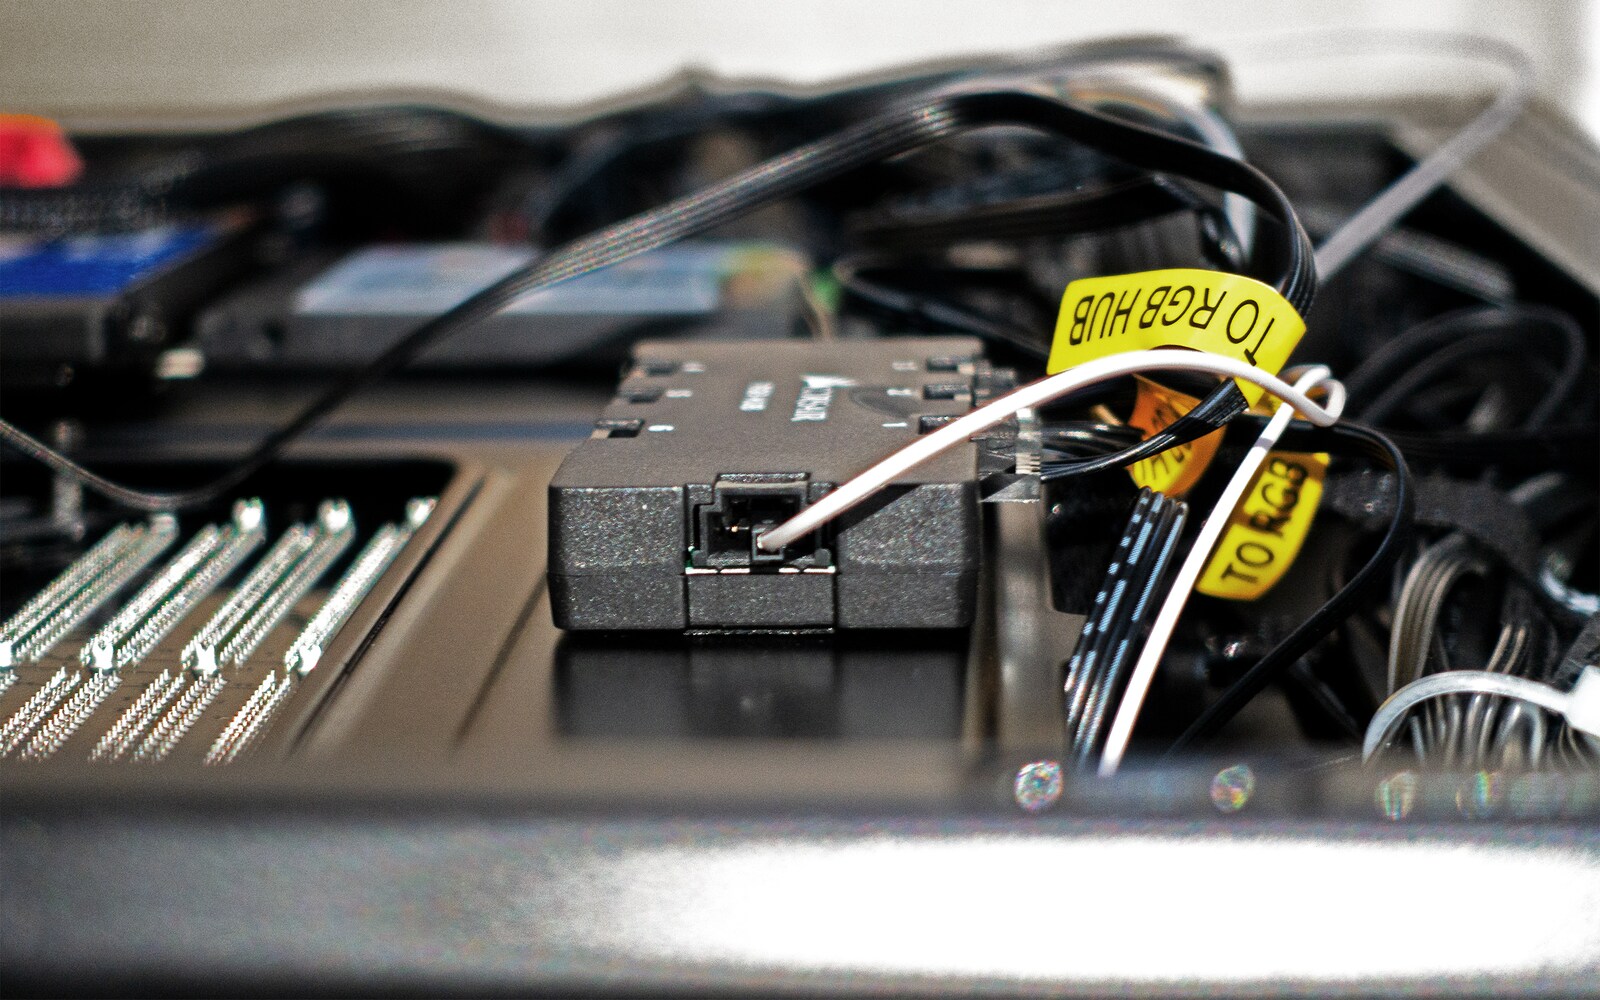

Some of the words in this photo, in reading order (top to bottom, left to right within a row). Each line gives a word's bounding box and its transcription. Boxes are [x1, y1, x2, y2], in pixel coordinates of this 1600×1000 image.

[1069, 288, 1142, 346] HUB
[1138, 284, 1227, 330] RGB
[1226, 299, 1276, 367] TO
[1220, 541, 1275, 584] TO
[1250, 457, 1308, 539] RGB
